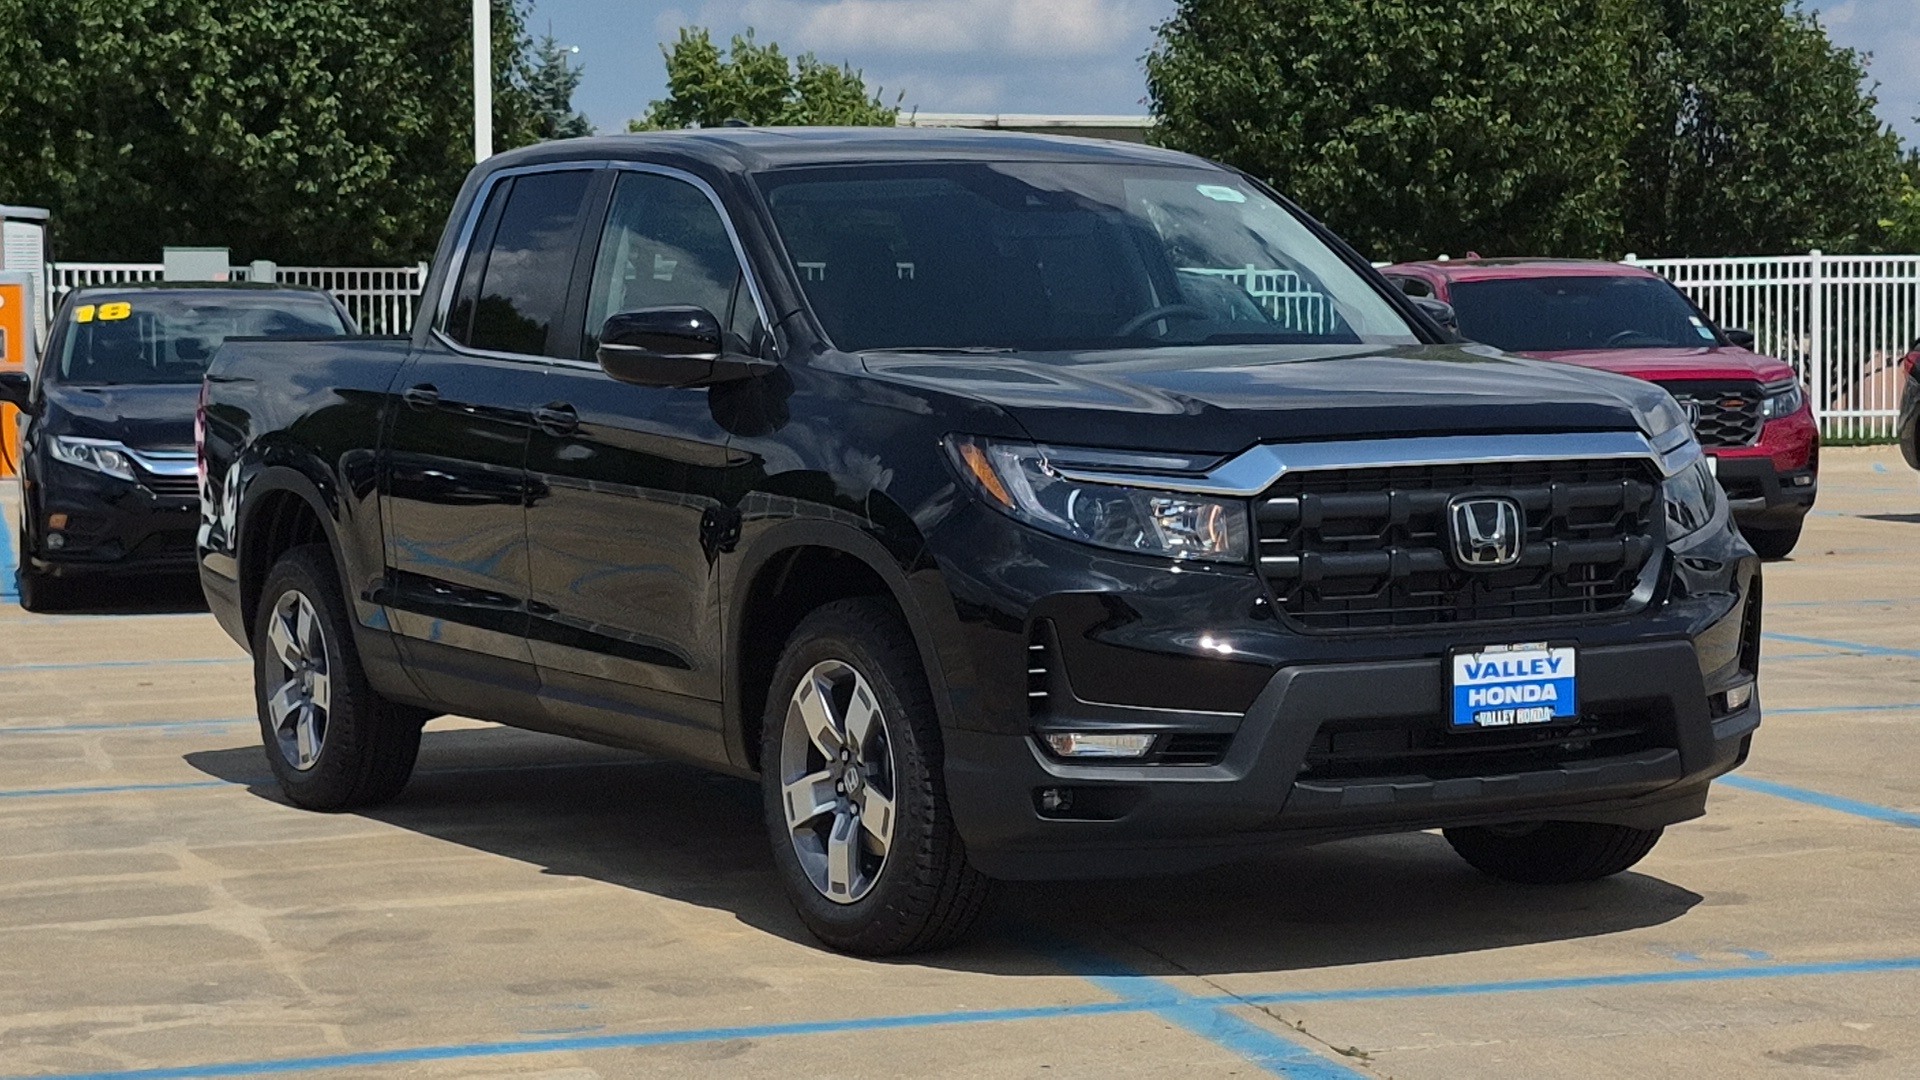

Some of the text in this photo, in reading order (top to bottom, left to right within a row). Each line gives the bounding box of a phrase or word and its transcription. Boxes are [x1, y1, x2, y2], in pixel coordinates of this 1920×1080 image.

[75, 302, 131, 323] 18
[1463, 656, 1562, 680] VALLEY
[1468, 683, 1558, 707] HONDA
[1480, 706, 1551, 726] VALLEY HONDA
